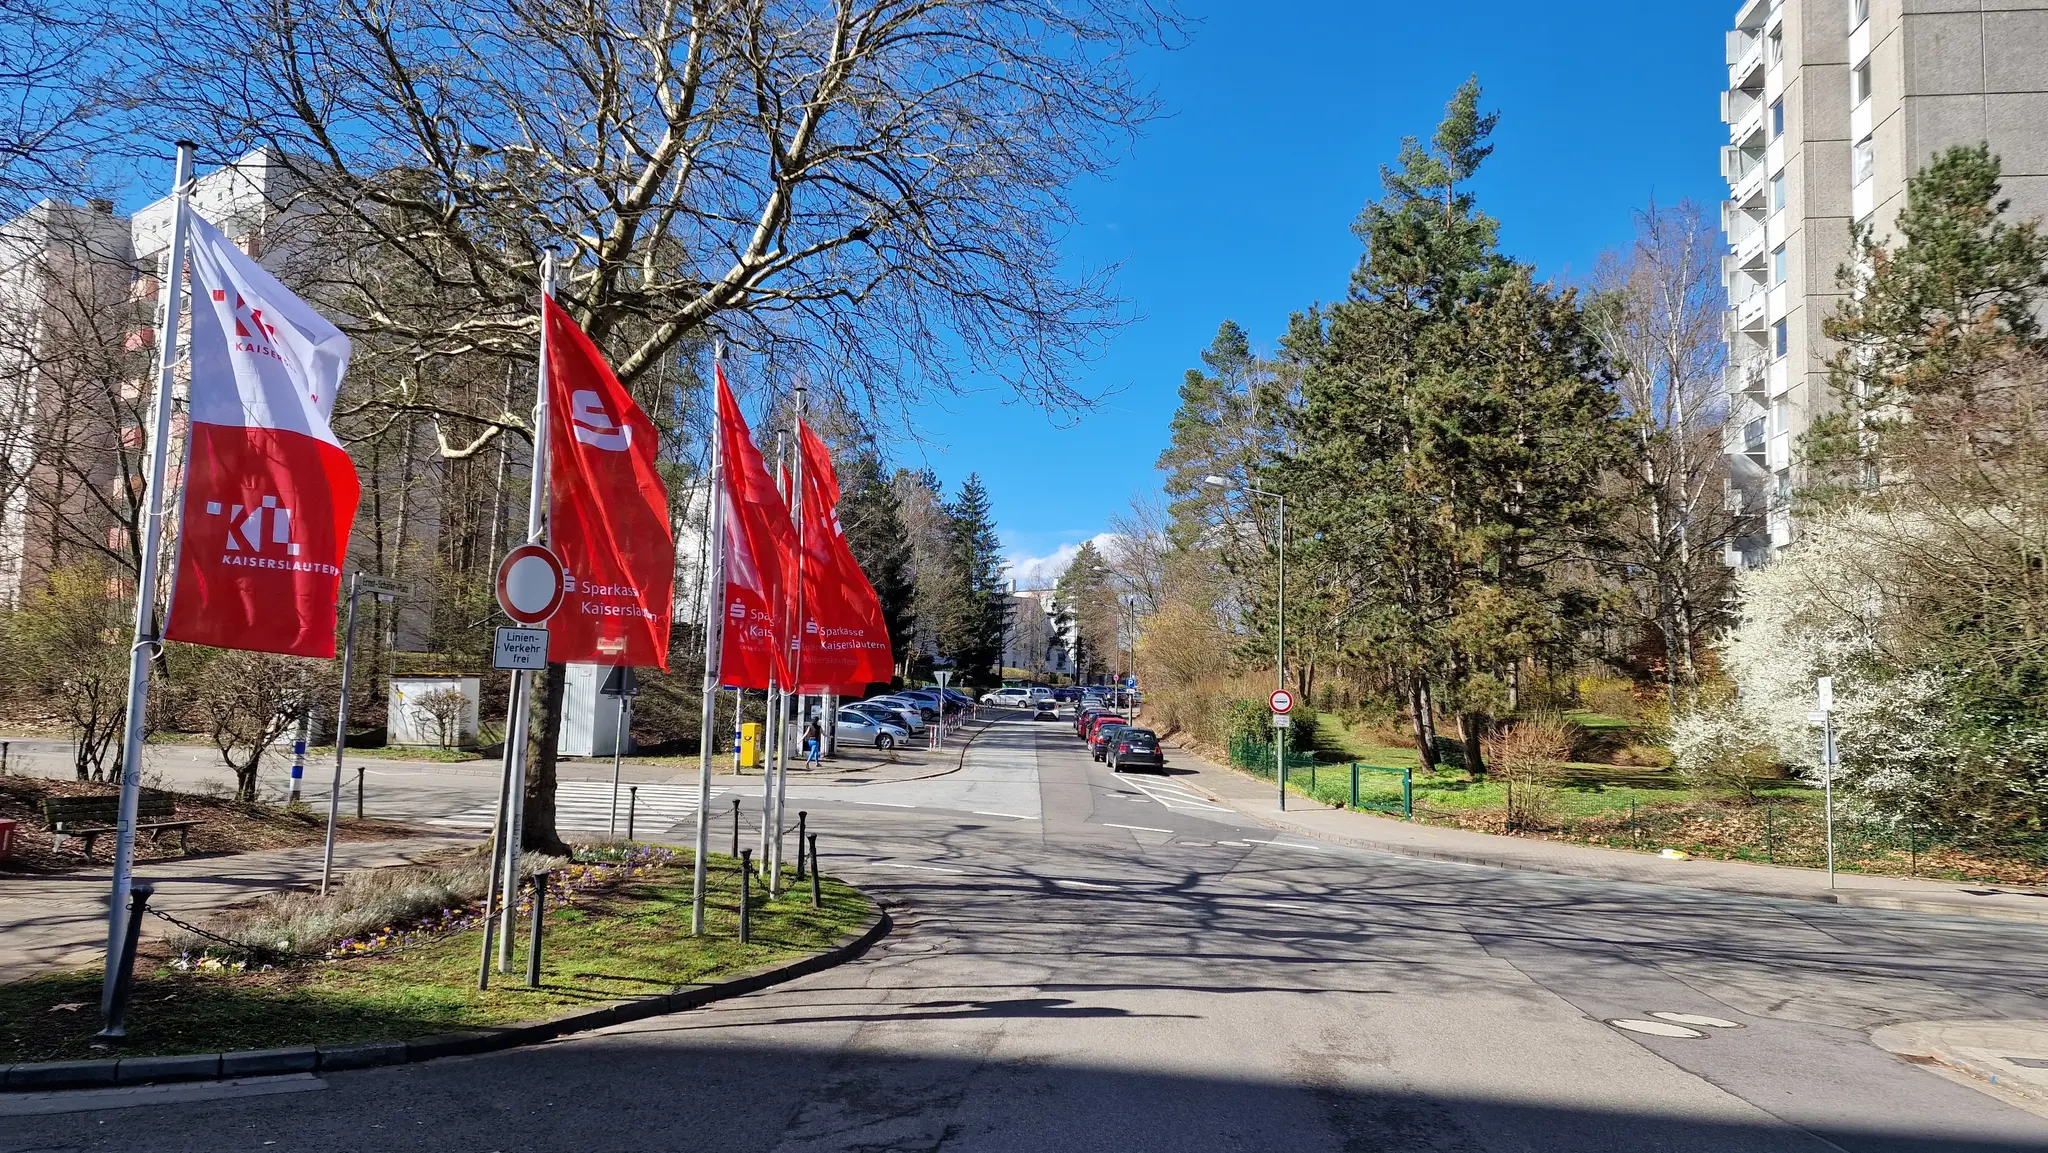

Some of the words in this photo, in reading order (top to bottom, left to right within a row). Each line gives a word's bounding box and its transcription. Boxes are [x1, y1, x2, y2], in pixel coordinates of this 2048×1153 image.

[506, 631, 540, 642] Linien-
[820, 626, 864, 638] Sparkasse
[503, 642, 541, 653] Verkehr
[820, 639, 886, 650] Kaiserslautern
[512, 653, 530, 664] frei
